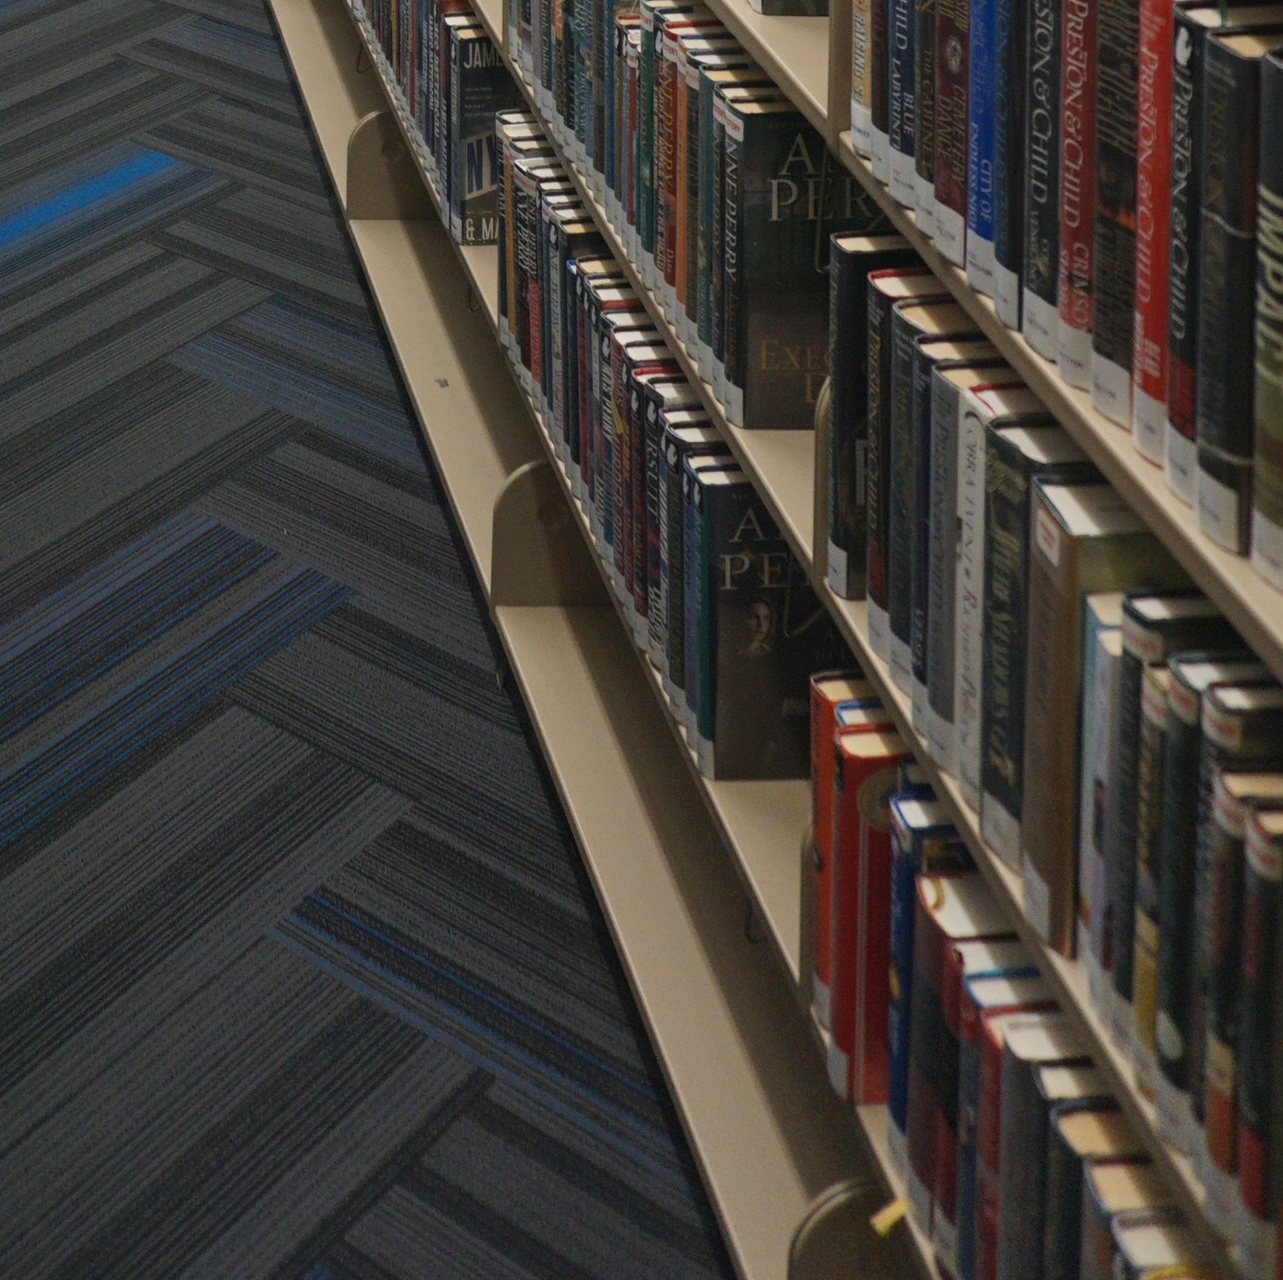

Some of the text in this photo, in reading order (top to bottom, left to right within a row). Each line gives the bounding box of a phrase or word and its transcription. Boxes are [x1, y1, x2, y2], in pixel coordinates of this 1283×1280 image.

[853, 14, 867, 80] RAISING
[903, 91, 915, 138] BLUE
[1033, 81, 1051, 109] &
[1065, 111, 1082, 140] &
[1137, 46, 1159, 166] PRESTON
[980, 158, 993, 224] CITY OF
[1031, 110, 1053, 205] CHILD
[1064, 138, 1084, 229] CHILD
[724, 201, 738, 282] PERRY
[1171, 75, 1193, 340] PRESTON CHILD
[1136, 207, 1154, 304] CHILD
